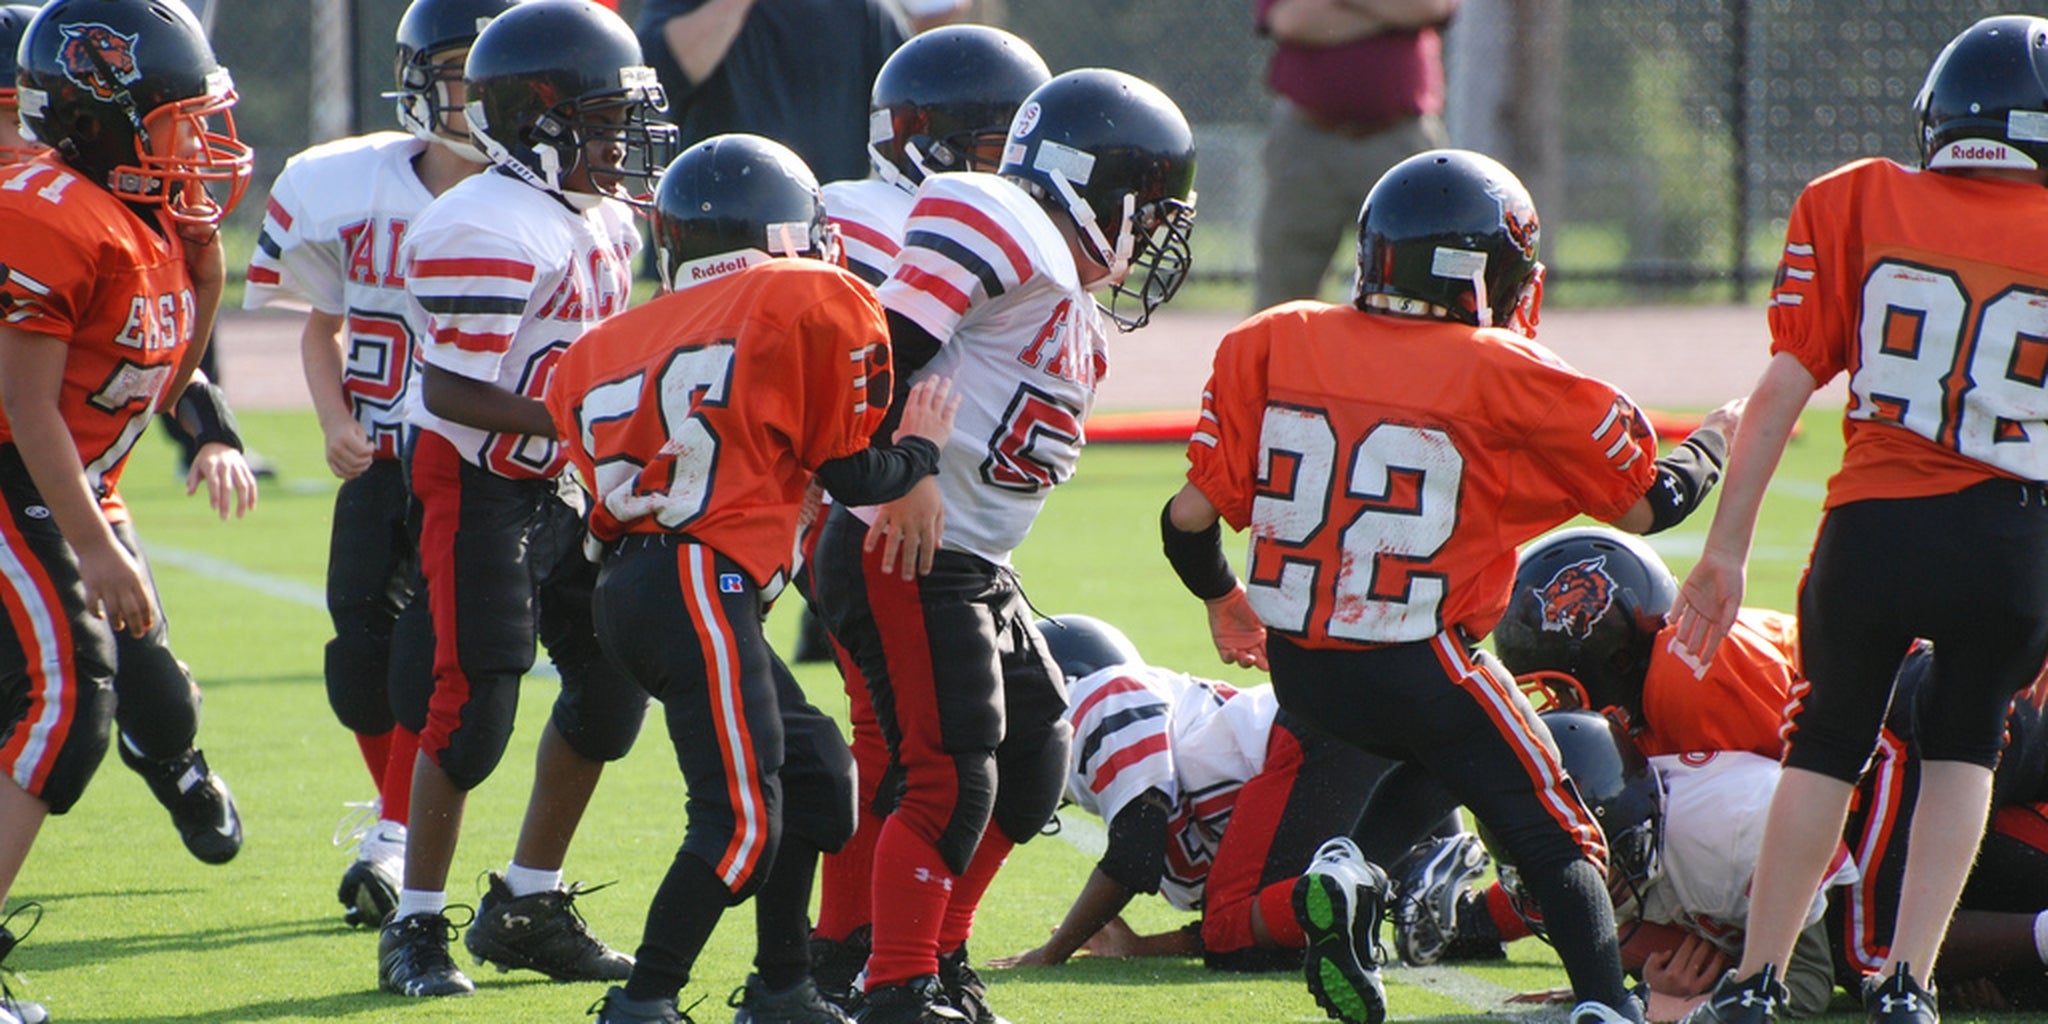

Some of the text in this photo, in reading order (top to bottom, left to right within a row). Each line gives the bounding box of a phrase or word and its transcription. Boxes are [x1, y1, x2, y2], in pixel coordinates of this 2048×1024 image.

[1951, 144, 2007, 160] Riddell
[691, 256, 747, 280] Riddell
[1848, 256, 2048, 482] 88
[1244, 400, 1466, 644] 22
